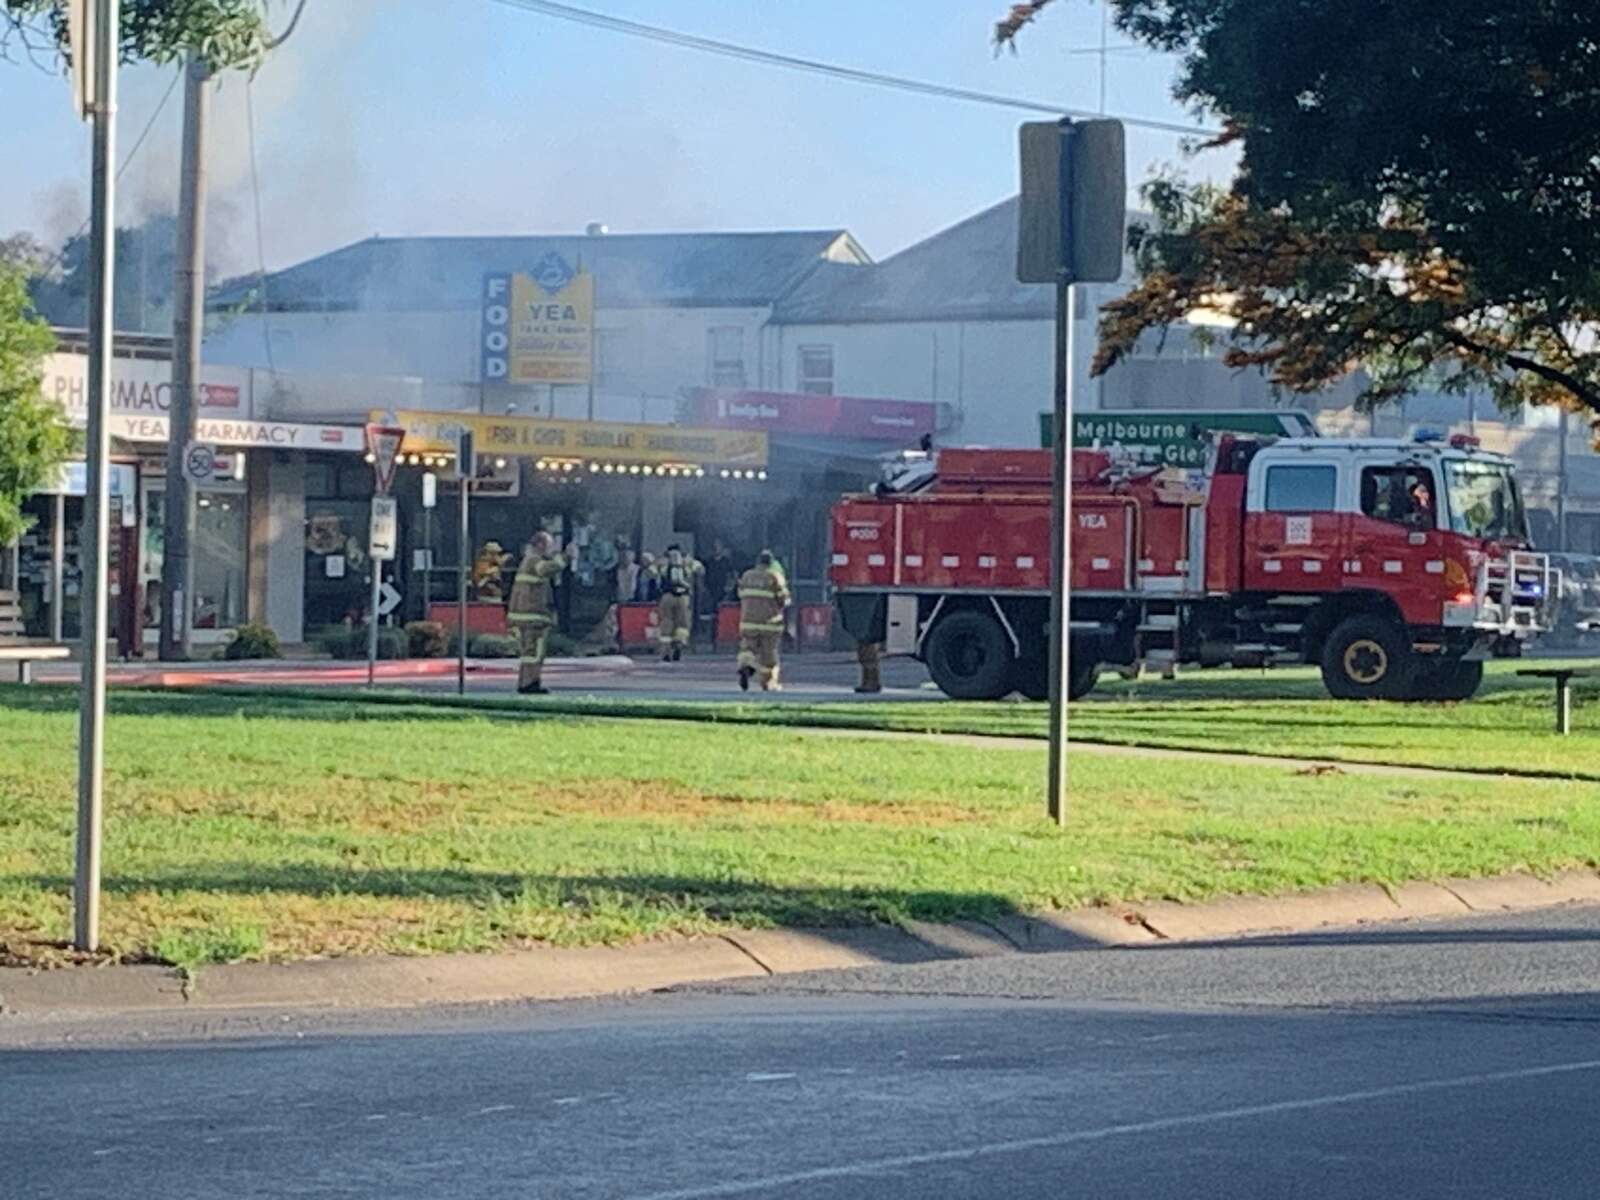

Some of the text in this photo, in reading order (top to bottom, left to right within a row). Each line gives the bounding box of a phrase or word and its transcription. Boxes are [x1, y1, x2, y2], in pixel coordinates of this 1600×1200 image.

[528, 304, 577, 321] YEA
[485, 278, 508, 378] FOOD
[55, 375, 172, 410] PHRMAC
[126, 418, 166, 437] YEA
[196, 421, 300, 444] HARMACY
[1076, 421, 1186, 439] Melbourne
[190, 454, 213, 471] 50
[1079, 514, 1107, 528] YEA
